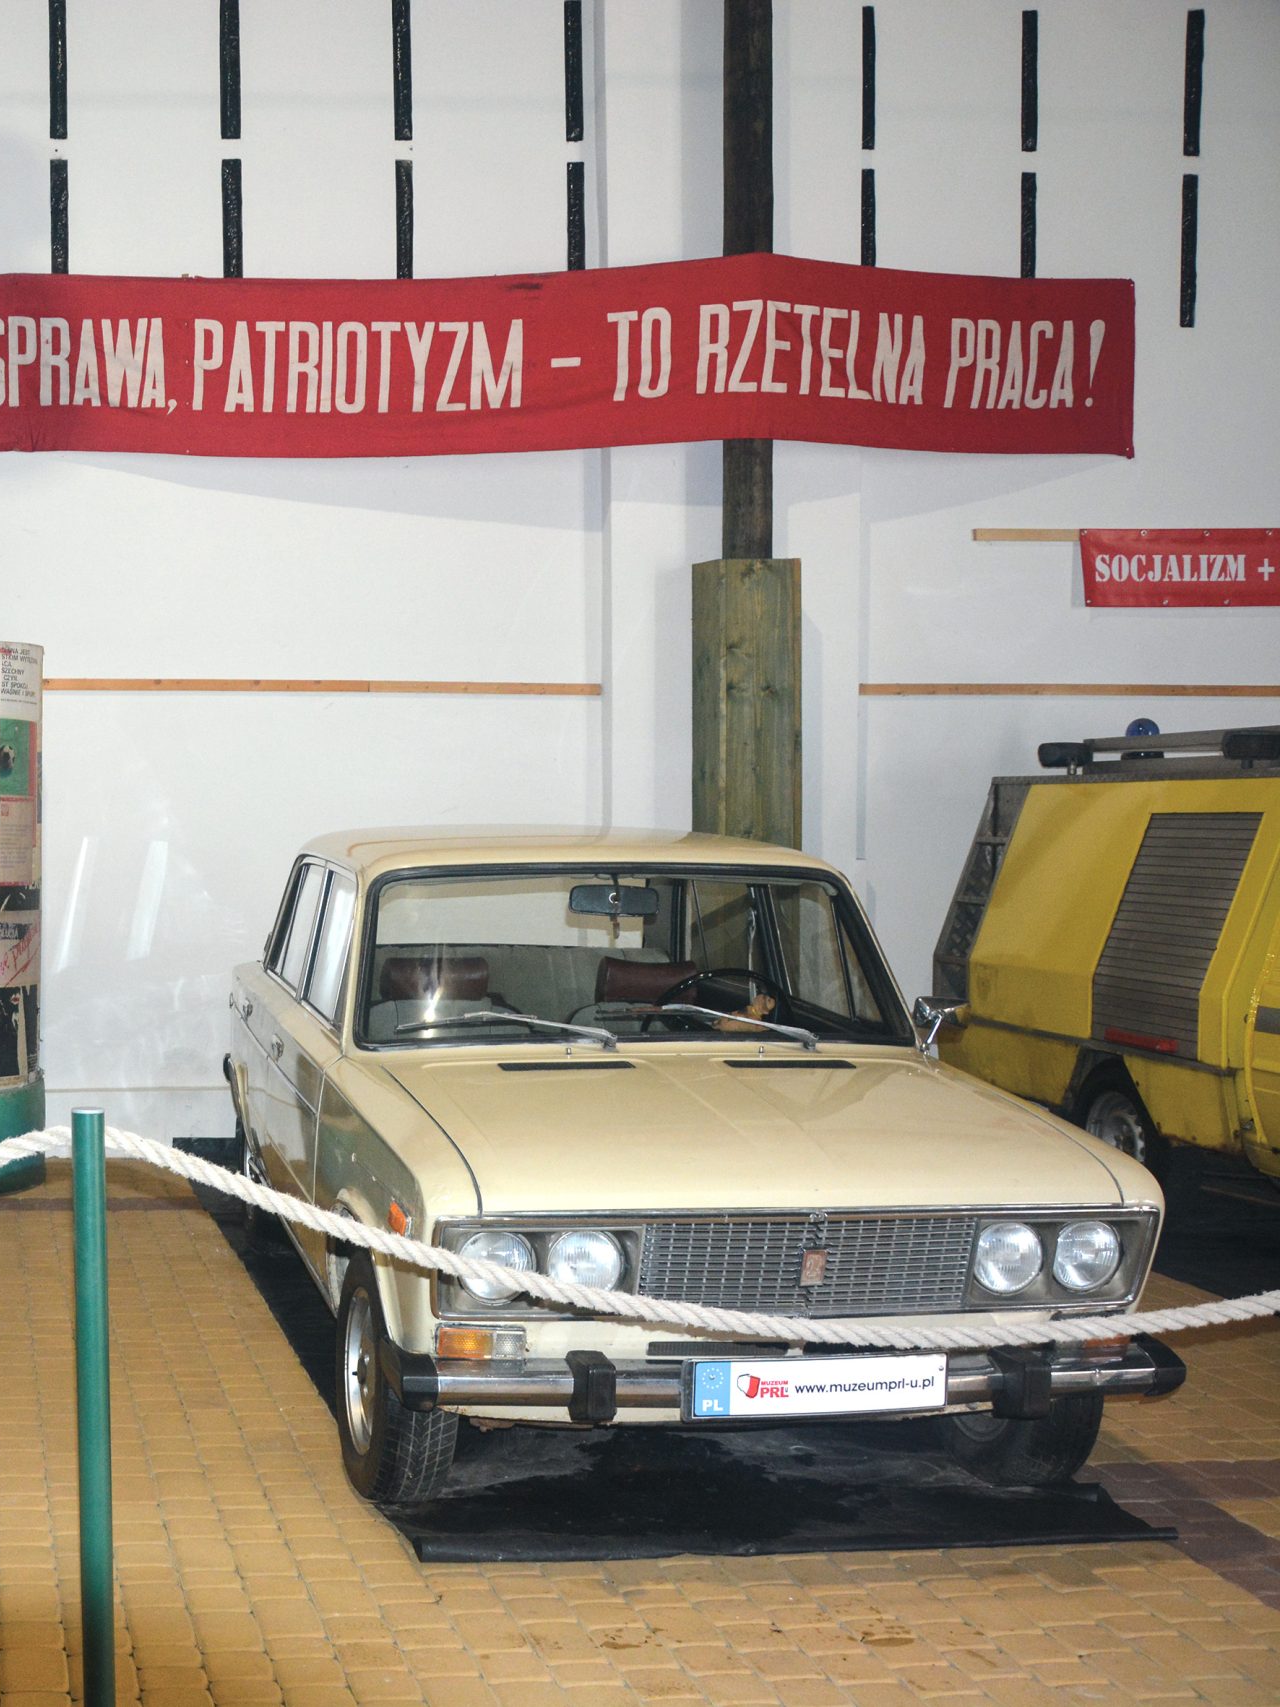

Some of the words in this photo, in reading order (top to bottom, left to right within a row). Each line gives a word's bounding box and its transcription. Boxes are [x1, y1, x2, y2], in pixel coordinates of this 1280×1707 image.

[192, 318, 523, 414] PATRIOTYZM
[607, 306, 672, 402] TO
[695, 299, 924, 406] RZETELNA
[1095, 554, 1246, 582] SOCJALIZM
[760, 1386, 789, 1398] PRL
[794, 1375, 936, 1394] www.muzeumprl-u.pl
[701, 1398, 724, 1412] PL
